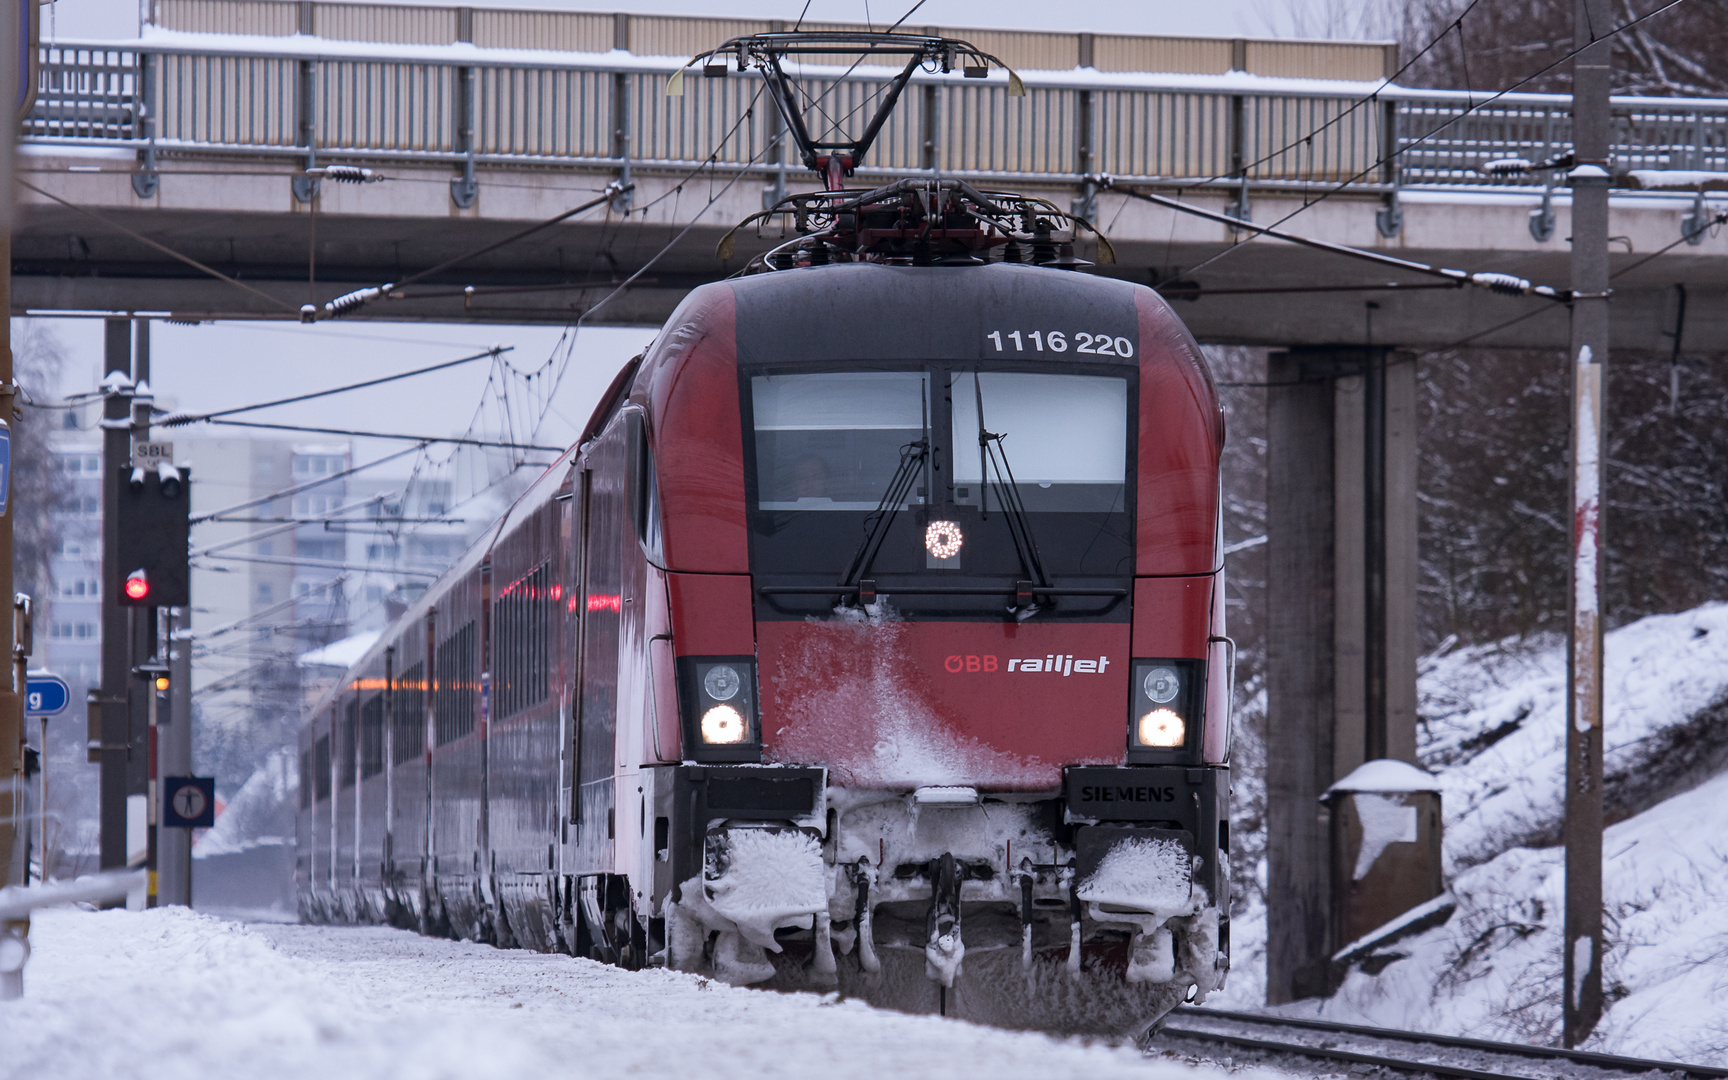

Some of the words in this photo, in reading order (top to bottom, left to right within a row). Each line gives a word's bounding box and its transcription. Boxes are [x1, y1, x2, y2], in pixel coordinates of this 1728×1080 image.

[987, 330, 1068, 352] 1116
[1075, 332, 1134, 358] 220
[137, 444, 171, 458] SBL
[1007, 654, 1110, 677] railjet
[1081, 786, 1175, 802] SIEMENS
